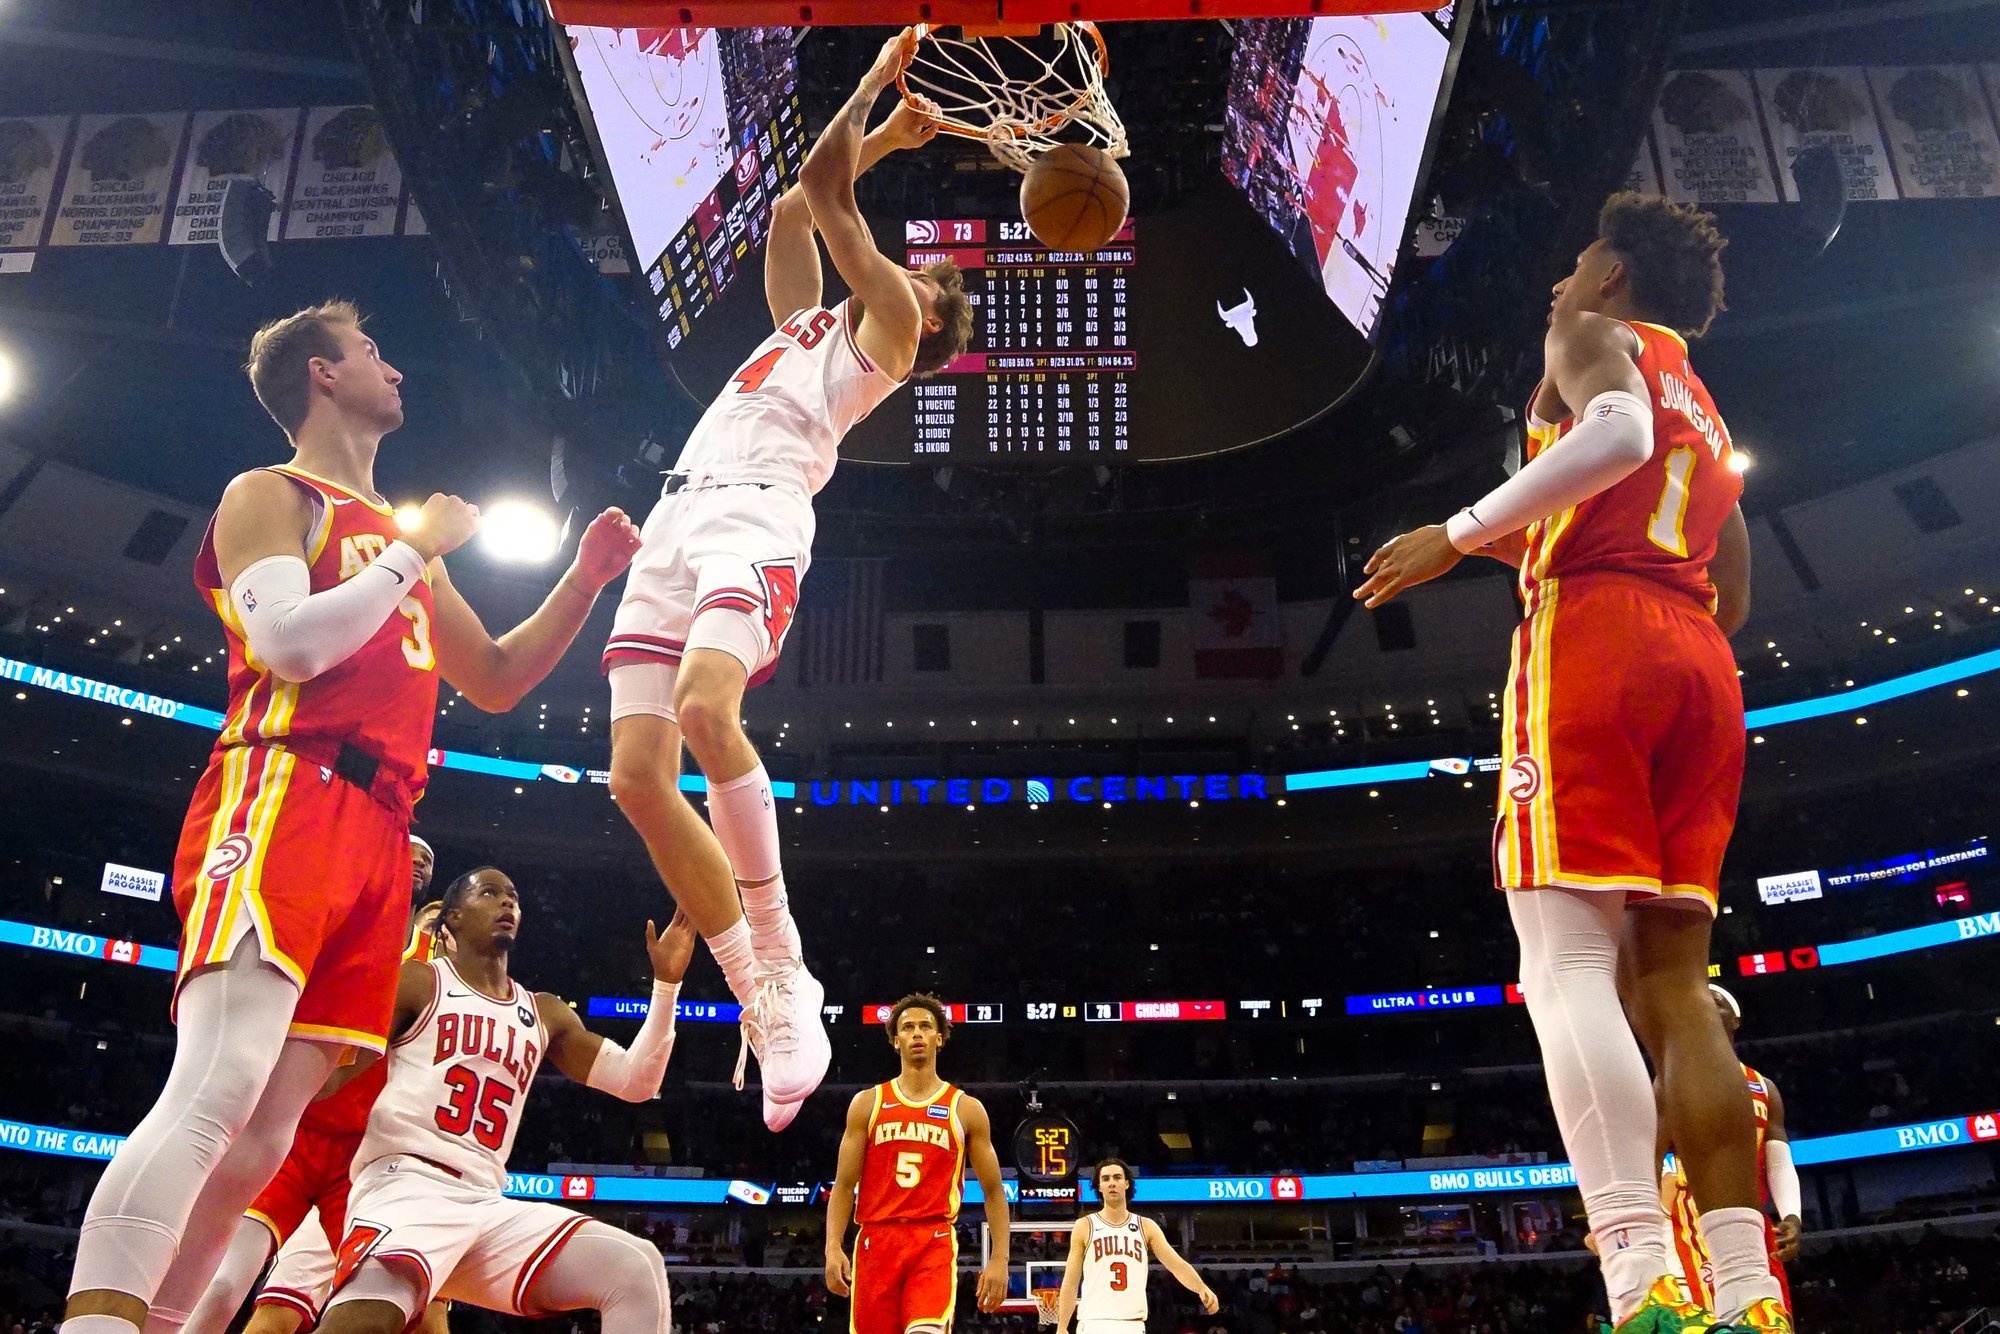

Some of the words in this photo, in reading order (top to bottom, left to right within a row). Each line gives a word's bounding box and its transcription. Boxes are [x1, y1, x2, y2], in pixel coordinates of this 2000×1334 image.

[322, 171, 375, 182] CHICAGO
[304, 184, 388, 196] BLACKHAWKS
[351, 197, 397, 208] DIVISION
[745, 185, 761, 212] 73
[73, 218, 144, 230] CHAMPIONS
[306, 211, 378, 222] CHAMPIONS
[726, 201, 745, 242] 5:27
[954, 224, 972, 240] 73
[1000, 222, 1030, 240] 5:27
[910, 253, 946, 264] ATLANTA
[996, 254, 1014, 263] 27/62
[1015, 254, 1032, 262] 43.5%
[1049, 253, 1064, 262] 6/22
[1065, 253, 1084, 262] 27.3%
[1096, 252, 1112, 262] 13/19
[1056, 279, 1068, 290] 0/0
[1085, 279, 1097, 289] 0/0
[1113, 278, 1125, 289] 2/2
[987, 295, 995, 305] 15
[1056, 293, 1068, 304] 2/5
[1087, 293, 1097, 303] 1/3
[1115, 293, 1125, 303] 1/2
[987, 309, 995, 319] 16
[1057, 308, 1068, 318] 3/6
[1087, 307, 1097, 318] 1/2
[1114, 307, 1126, 317] 0/4
[987, 323, 996, 333] 22
[1019, 323, 1027, 333] 19
[1057, 322, 1072, 332] 8/15
[1086, 322, 1097, 332] 0/3
[1114, 321, 1126, 332] 3/3
[988, 337, 996, 348] 21
[1057, 336, 1068, 346] 0/2
[1086, 336, 1098, 346] 0/0
[1114, 336, 1126, 346] 0/0
[998, 358, 1016, 368] 30/60
[1017, 358, 1034, 367] 50.0%
[1050, 358, 1065, 367] 9/29
[1066, 357, 1084, 366] 31.0%
[1098, 357, 1112, 367] 9/14
[1112, 357, 1132, 366] 64.3%
[732, 347, 789, 394] 4
[914, 386, 922, 396] 13
[925, 386, 957, 396] HUERTER
[988, 385, 996, 395] 13
[1020, 385, 1028, 395] 13
[1058, 384, 1069, 394] 5/6
[1088, 383, 1098, 394] 1/2
[1115, 383, 1127, 393] 2/2
[925, 400, 955, 410] VUCEVIC
[988, 399, 997, 409] 22
[1020, 399, 1028, 409] 13
[1058, 398, 1070, 408] 5/8
[1088, 397, 1098, 408] 1/3
[1115, 397, 1127, 407] 2/2
[915, 415, 923, 424] 14
[926, 414, 954, 424] BUZELIS
[988, 413, 998, 423] 20
[1058, 412, 1073, 422] 3/10
[1088, 412, 1099, 422] 1/5
[1115, 412, 1127, 422] 2/3
[1658, 370, 1724, 462] JOHNSON
[926, 428, 950, 438] GIDDEY
[988, 427, 998, 438] 23
[1021, 427, 1028, 437] 13
[1058, 426, 1070, 437] 5/8
[1089, 426, 1099, 436] 1/3
[1115, 425, 1127, 436] 2/4
[914, 443, 923, 452] 35
[926, 442, 949, 452] OKORO
[990, 442, 997, 452] 16
[1058, 440, 1070, 451] 3/6
[1089, 440, 1099, 450] 1/3
[1116, 440, 1127, 450] 0/0
[1647, 444, 1697, 559] 1
[398, 594, 436, 672] 3
[810, 779, 1012, 806] UNITED
[1068, 775, 1269, 802] CENTER
[1828, 876, 1852, 886] TEXT
[1906, 862, 1926, 872] FOR
[1928, 847, 1988, 868] ASSISTANCE
[108, 878, 156, 894] PROGRAM
[110, 872, 128, 881] FAN
[130, 874, 158, 887] ASSIST
[1766, 884, 1784, 892] FAN
[1785, 878, 1814, 890] ASSIST
[1766, 886, 1816, 898] PROGRAM
[1956, 911, 2000, 939] BM
[30, 926, 96, 955] BMO
[1372, 996, 1415, 1008] ULTRA
[1429, 992, 1475, 1005] CLUB
[616, 1002, 648, 1014] ULTR
[674, 1005, 716, 1017] CLUB
[977, 1006, 992, 1020] 73
[1026, 1003, 1056, 1020] 5:27
[1096, 1004, 1110, 1018] 78
[1135, 1003, 1180, 1018] CHICAGO
[433, 1013, 538, 1096] BULLS
[434, 1064, 516, 1152] 35
[35, 1129, 68, 1150] THE
[874, 1121, 950, 1150] ATLANTA
[1036, 1128, 1069, 1145] 5:27
[1896, 1122, 1960, 1148] BMO
[1041, 1146, 1066, 1176] 15
[896, 1151, 923, 1188] 5
[1430, 1174, 1469, 1190] BMO
[1474, 1170, 1524, 1188] BULLS
[1529, 1166, 1576, 1185] DEBIT
[503, 1176, 554, 1196] BMO
[1036, 1188, 1075, 1197] TISSOT
[1208, 1180, 1264, 1199] BMO
[1093, 1235, 1142, 1263] BULLS
[1110, 1262, 1127, 1291] 3
